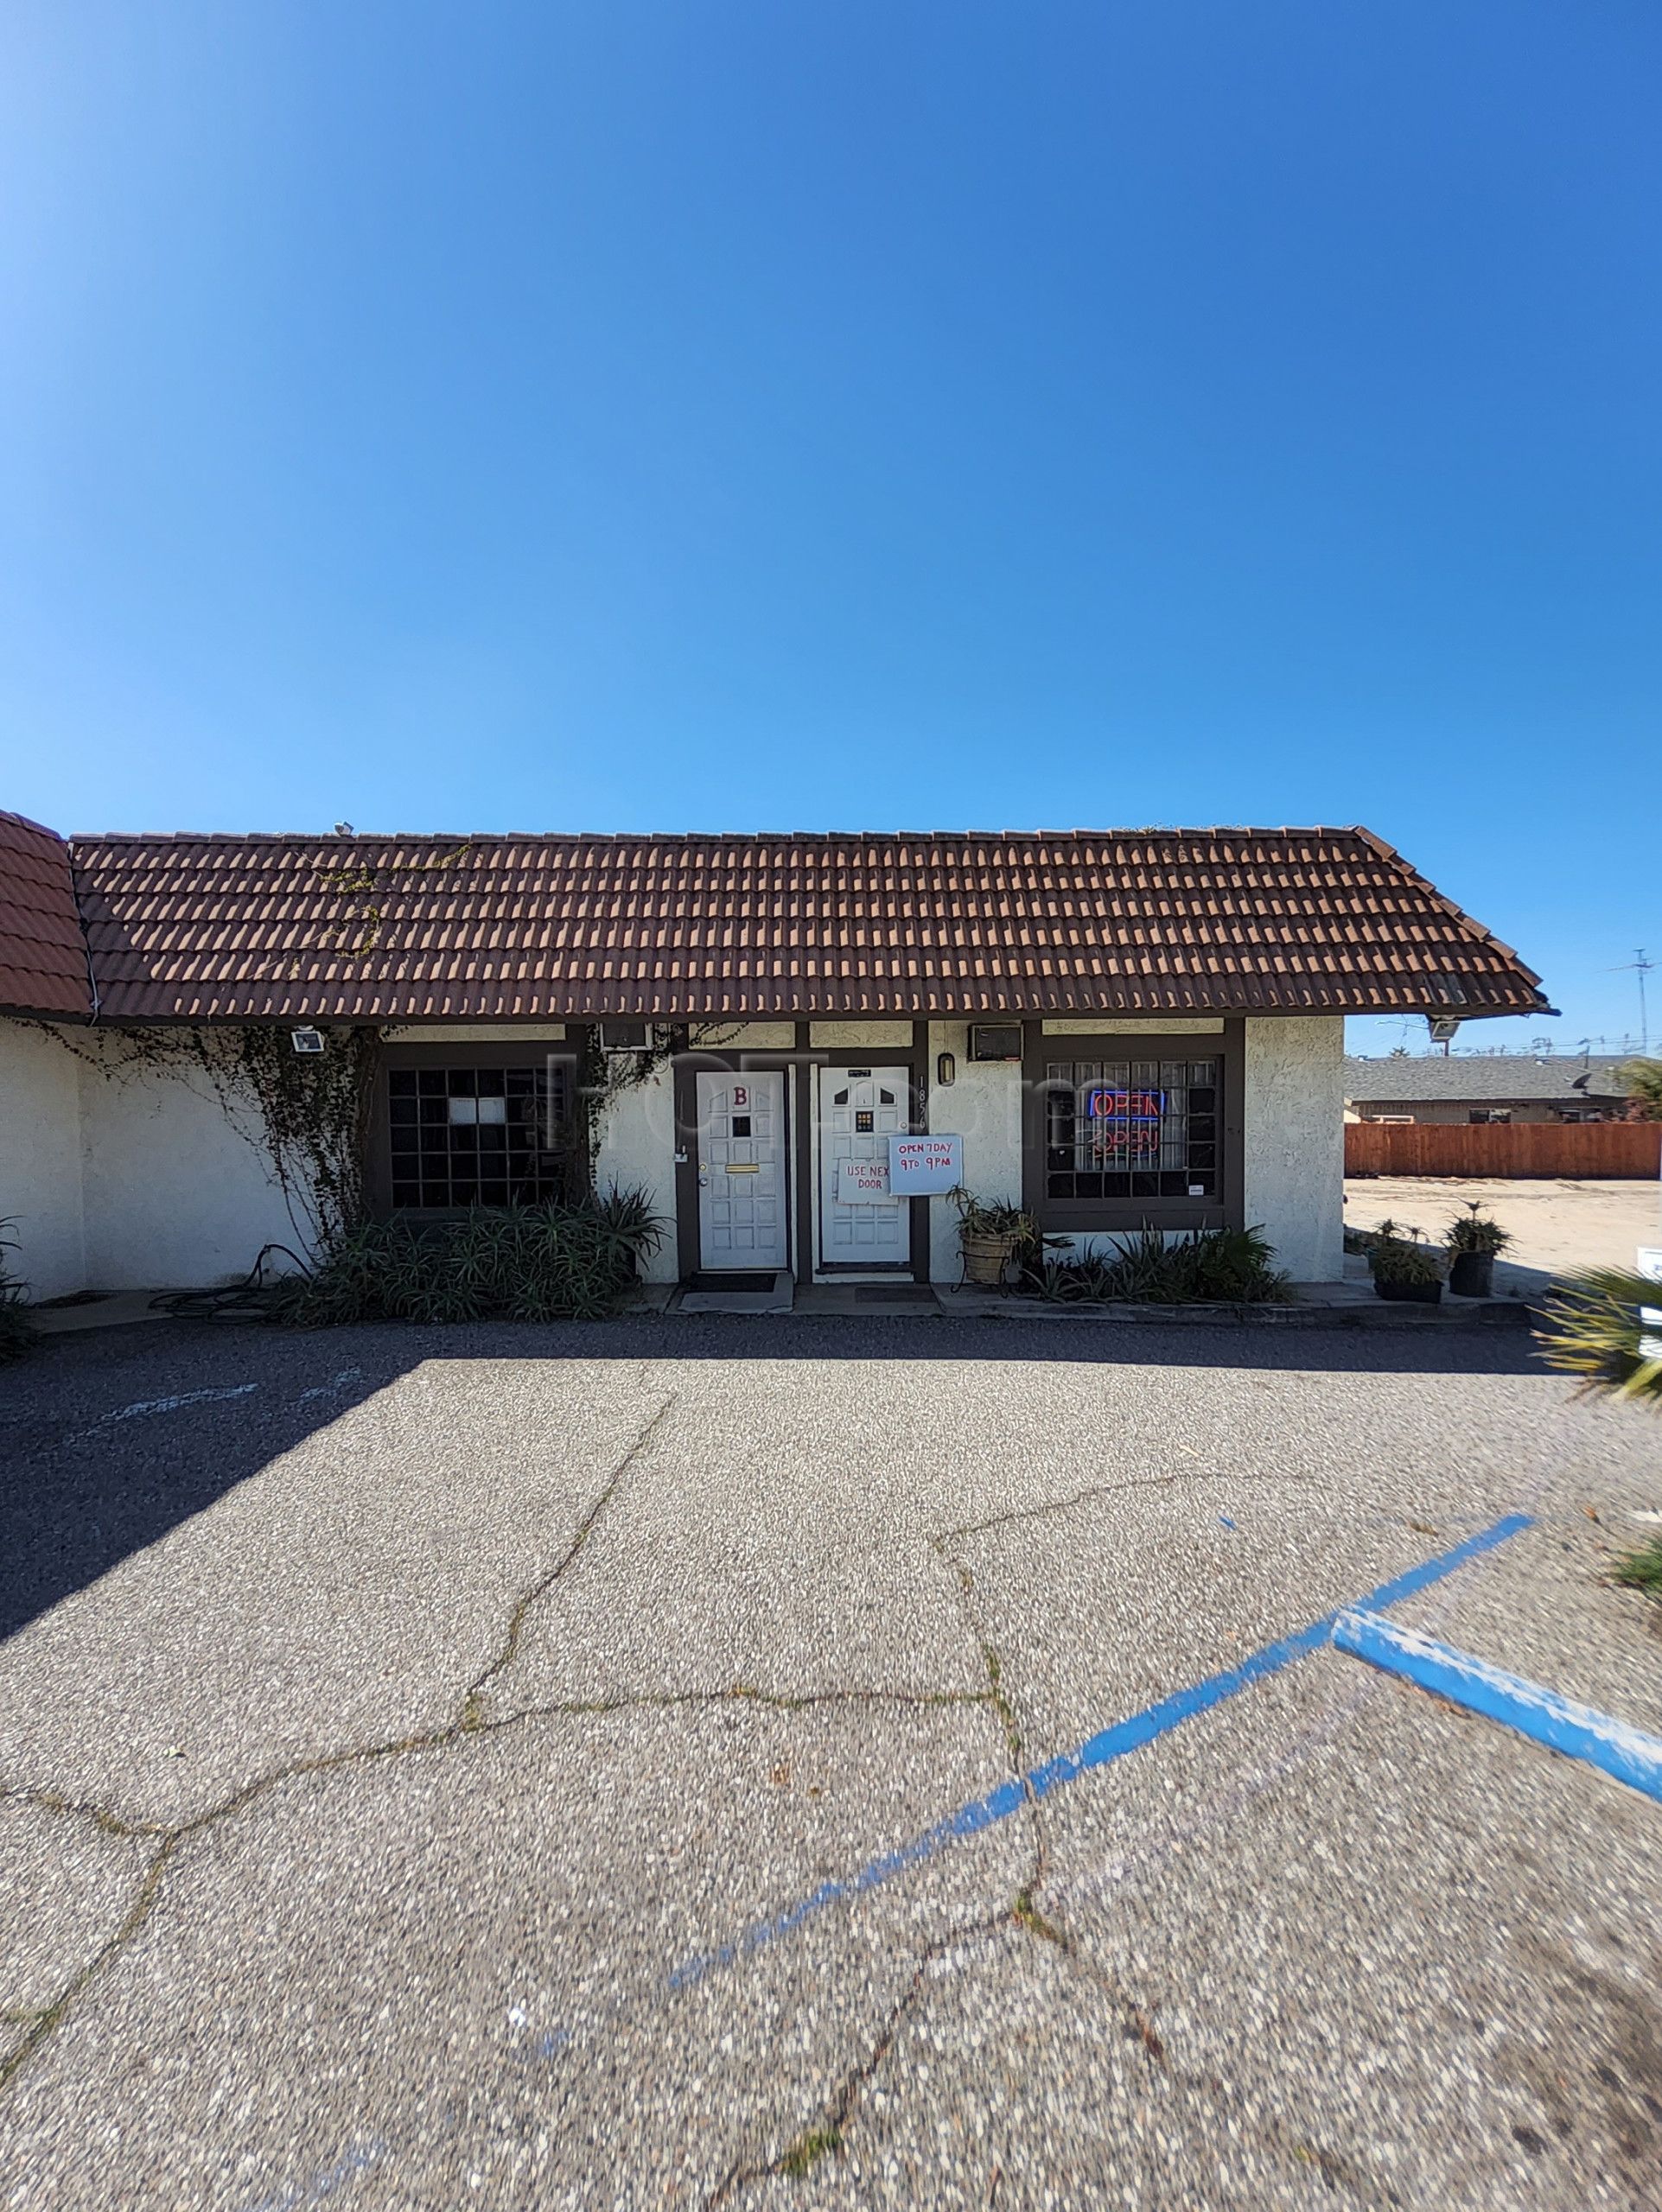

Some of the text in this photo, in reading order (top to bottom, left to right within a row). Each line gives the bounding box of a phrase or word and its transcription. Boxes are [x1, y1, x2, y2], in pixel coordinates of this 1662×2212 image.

[733, 1086, 748, 1106] B
[1094, 1094, 1158, 1116] OPEN
[1092, 1130, 1158, 1152] OPEN
[899, 1144, 924, 1154] OPEN
[847, 1166, 890, 1177] USE NEX
[857, 1179, 882, 1189] DOOR
